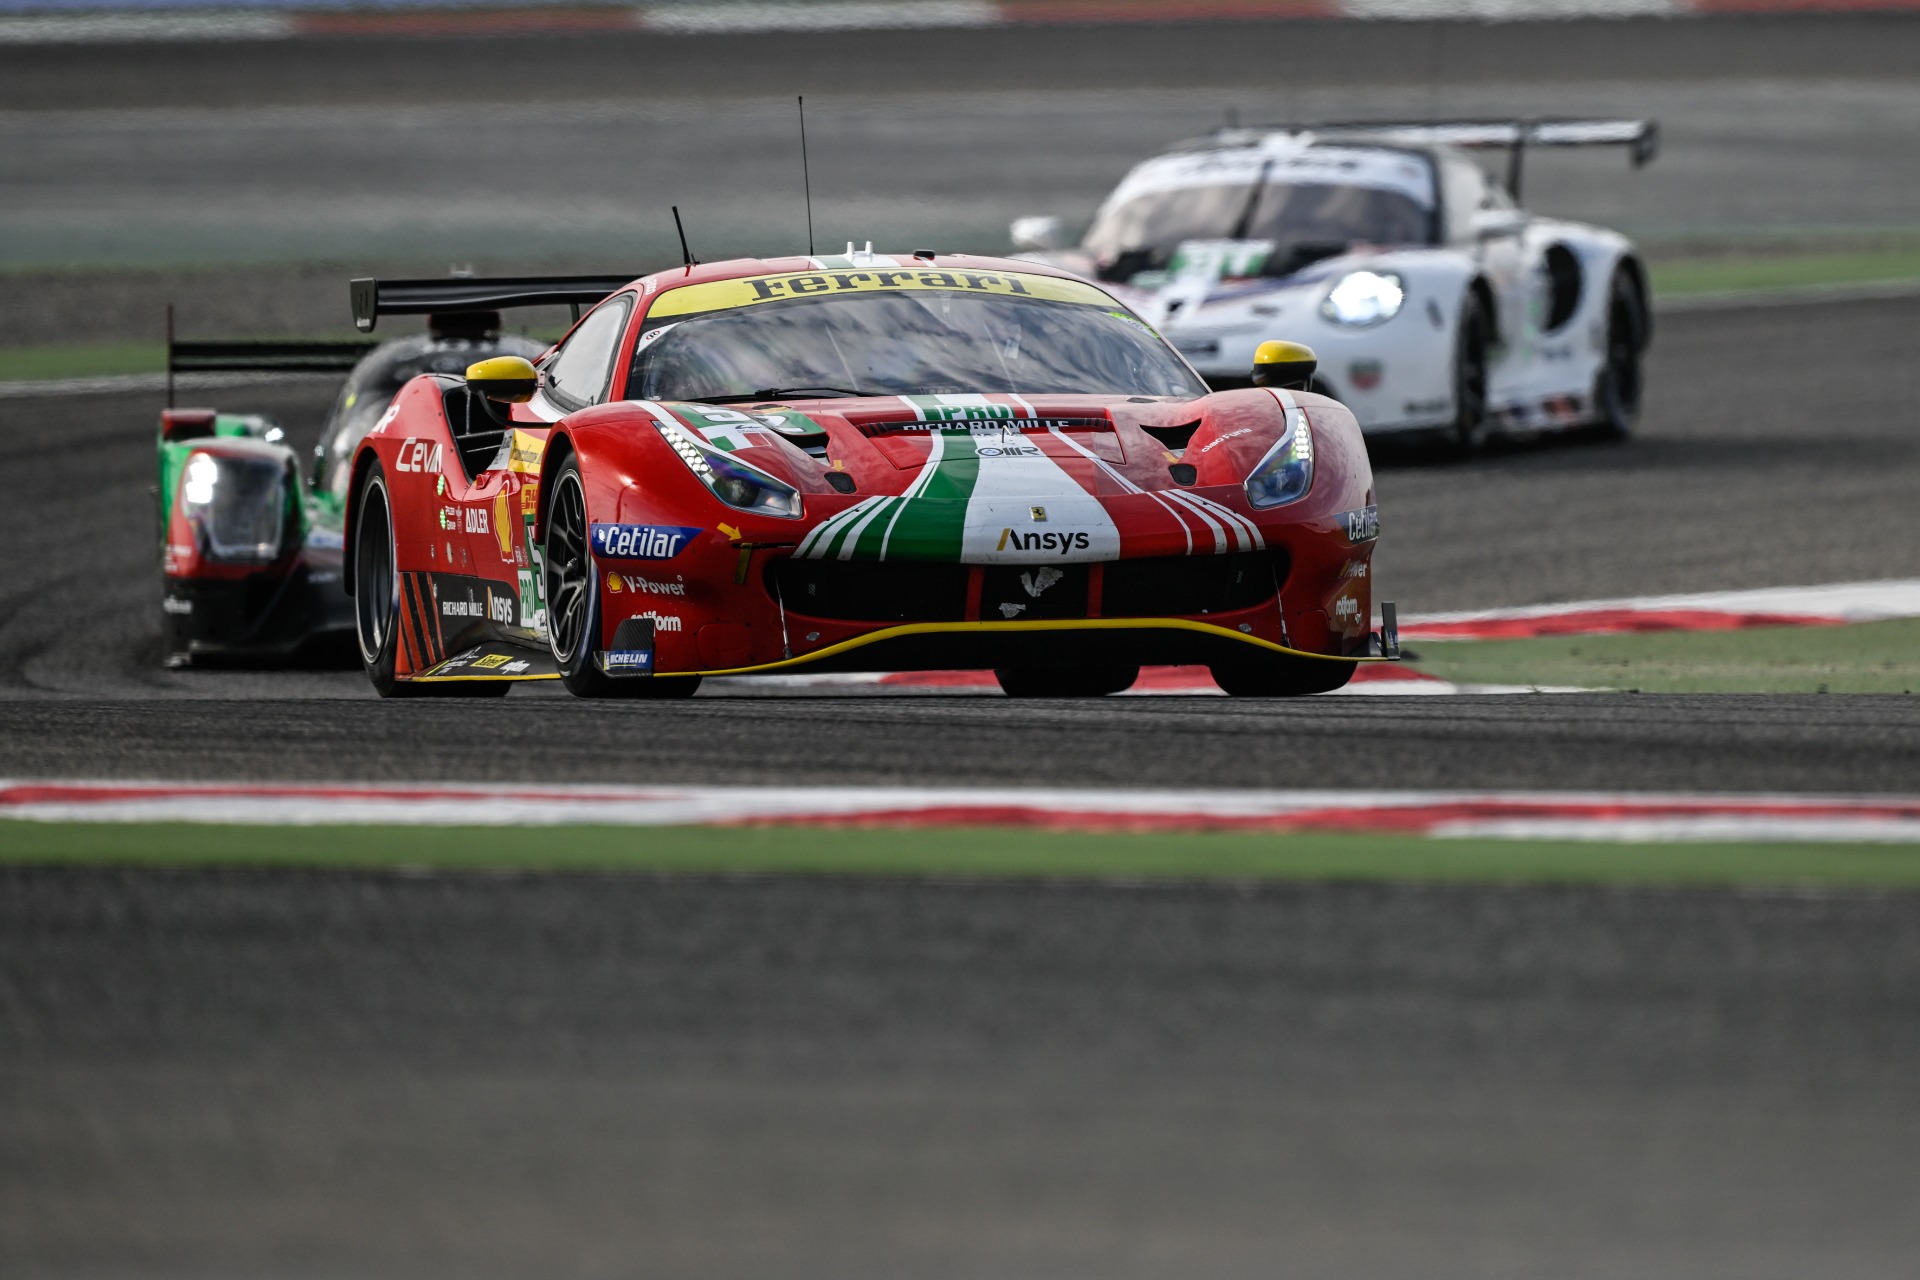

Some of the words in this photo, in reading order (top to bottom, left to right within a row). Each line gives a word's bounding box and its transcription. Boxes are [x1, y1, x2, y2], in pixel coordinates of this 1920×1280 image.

[743, 270, 1031, 301] Ferrari
[466, 507, 489, 534] ADLER
[605, 527, 680, 558] Cetilar
[996, 527, 1090, 555] Ansys
[623, 574, 685, 596] V-Power
[442, 601, 468, 616] RICHARD
[487, 586, 513, 629] Ansys
